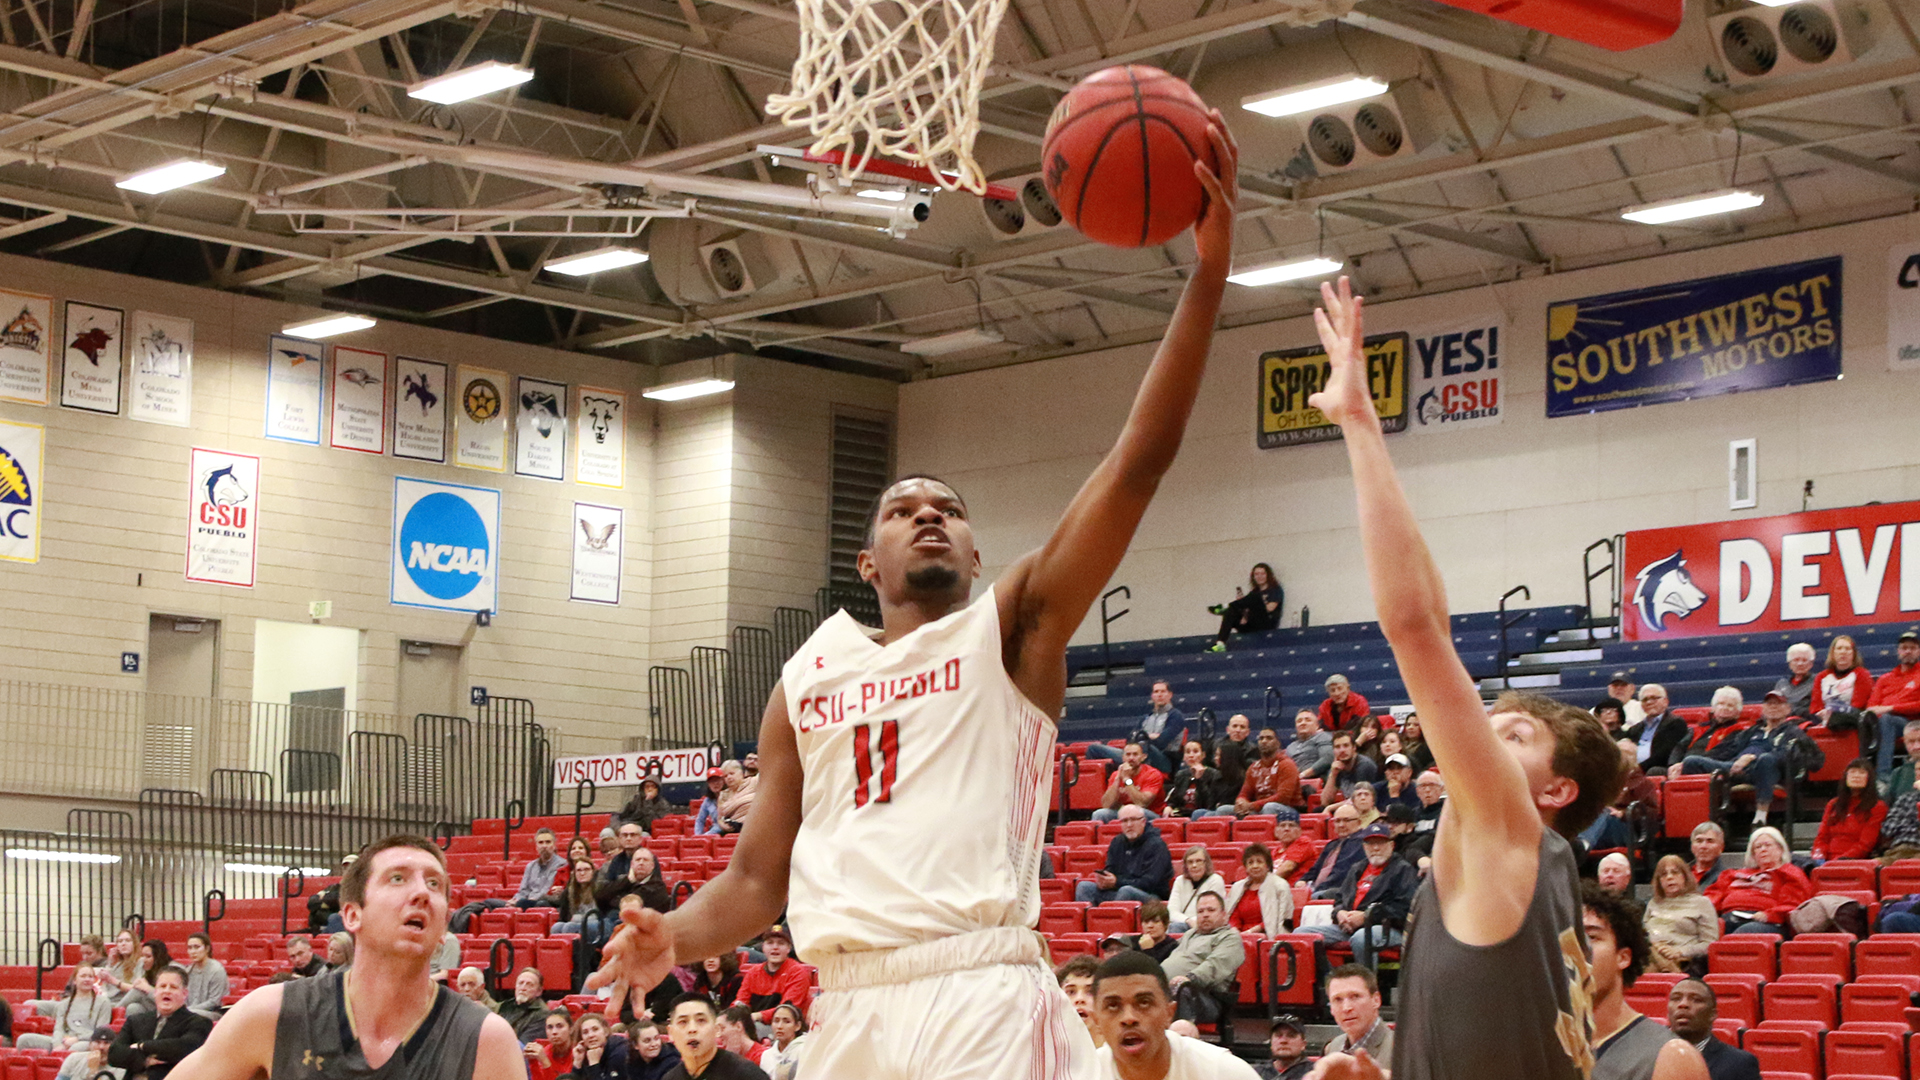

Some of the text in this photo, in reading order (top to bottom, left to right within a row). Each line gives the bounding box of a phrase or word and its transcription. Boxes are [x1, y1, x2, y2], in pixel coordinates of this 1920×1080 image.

[1551, 274, 1831, 393] SOUTHWEST
[1700, 318, 1836, 380] MOTORS
[1416, 326, 1499, 380] YES!
[71, 371, 112, 384] COLORADO
[140, 382, 181, 396] COLORADO
[1270, 351, 1398, 415] SPRAEY
[68, 389, 113, 404] UNIVERSITY
[1441, 378, 1499, 414] CSU
[1277, 413, 1297, 429] OH
[1301, 409, 1322, 425] YES
[1441, 406, 1499, 423] PUEBLO
[200, 501, 247, 529] CSU
[198, 526, 247, 539] PUEBLO
[407, 540, 487, 577] NCAA
[557, 751, 721, 784] VISITOR SCTIO
[854, 718, 899, 809] 11
